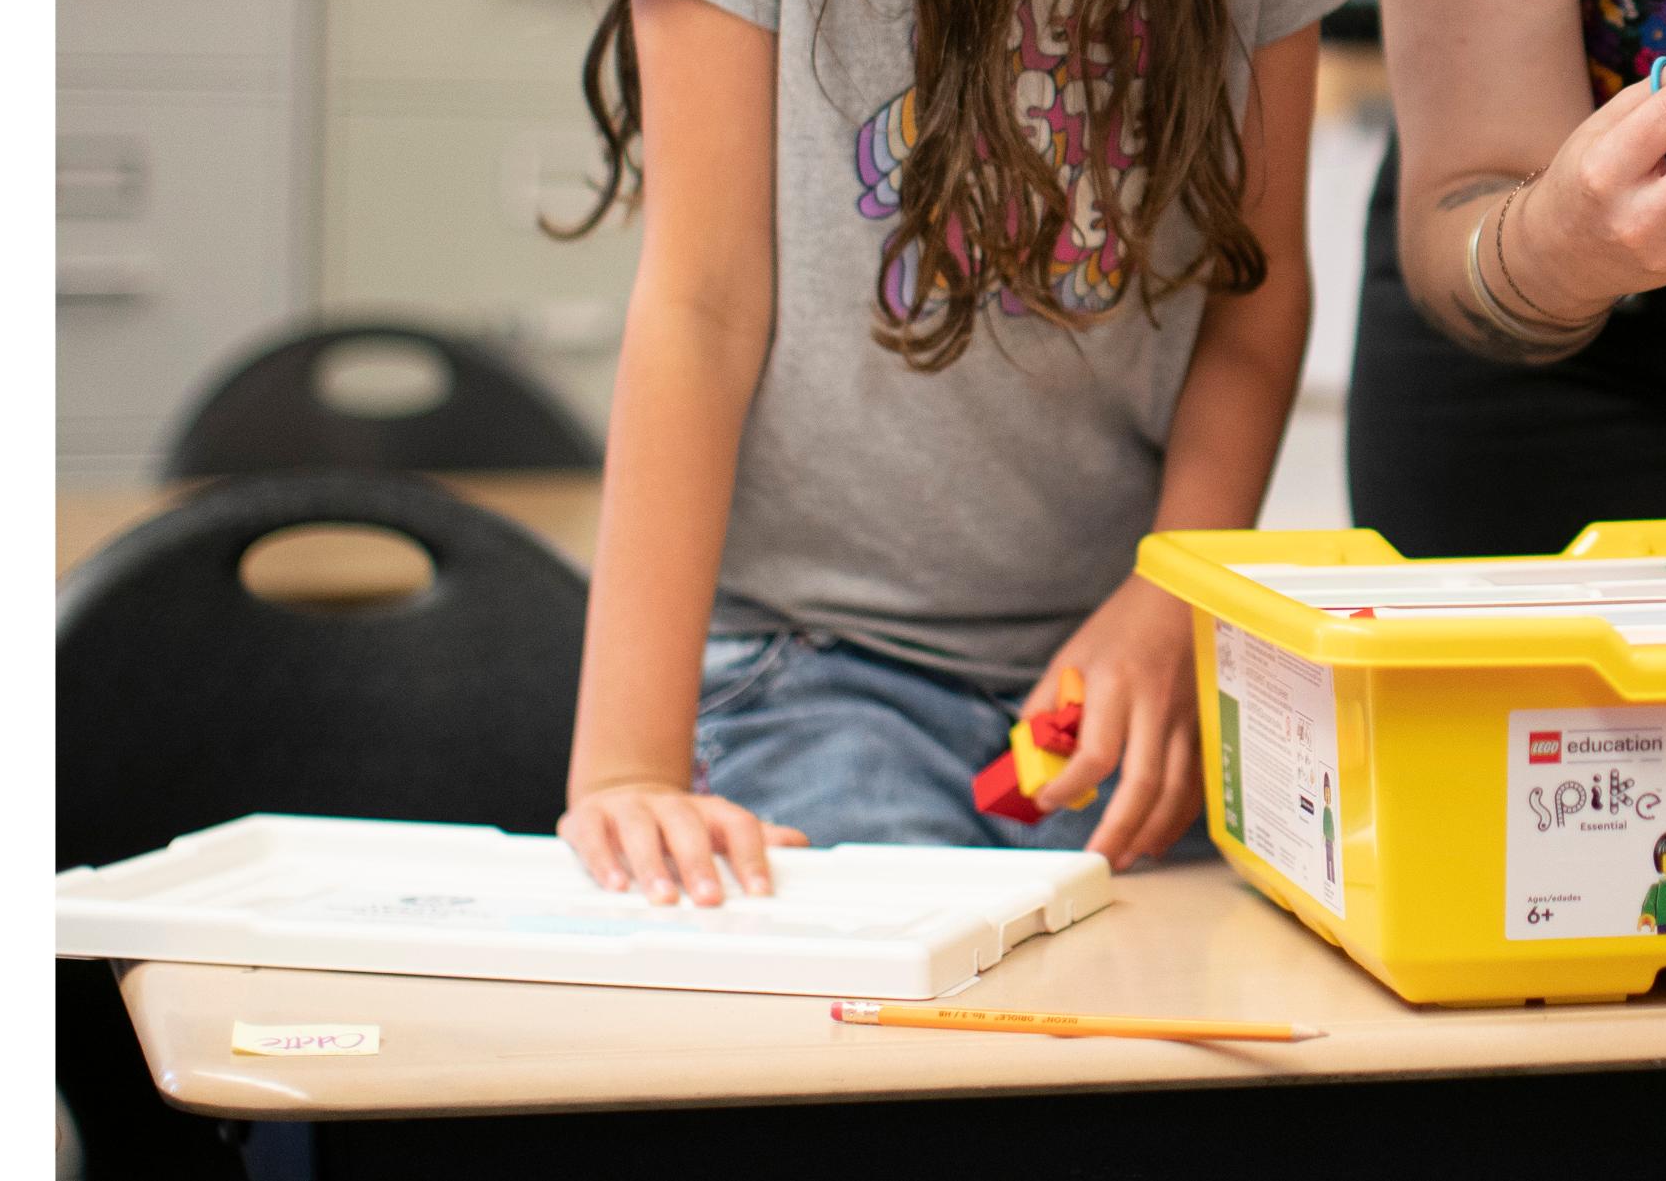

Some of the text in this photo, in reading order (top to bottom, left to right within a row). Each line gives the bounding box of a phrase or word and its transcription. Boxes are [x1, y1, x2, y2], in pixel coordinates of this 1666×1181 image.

[1530, 734, 1663, 755] LEGO education
[1580, 820, 1627, 831] Essential
[1527, 894, 1582, 904] Ages/edades
[1527, 906, 1554, 924] 6+
